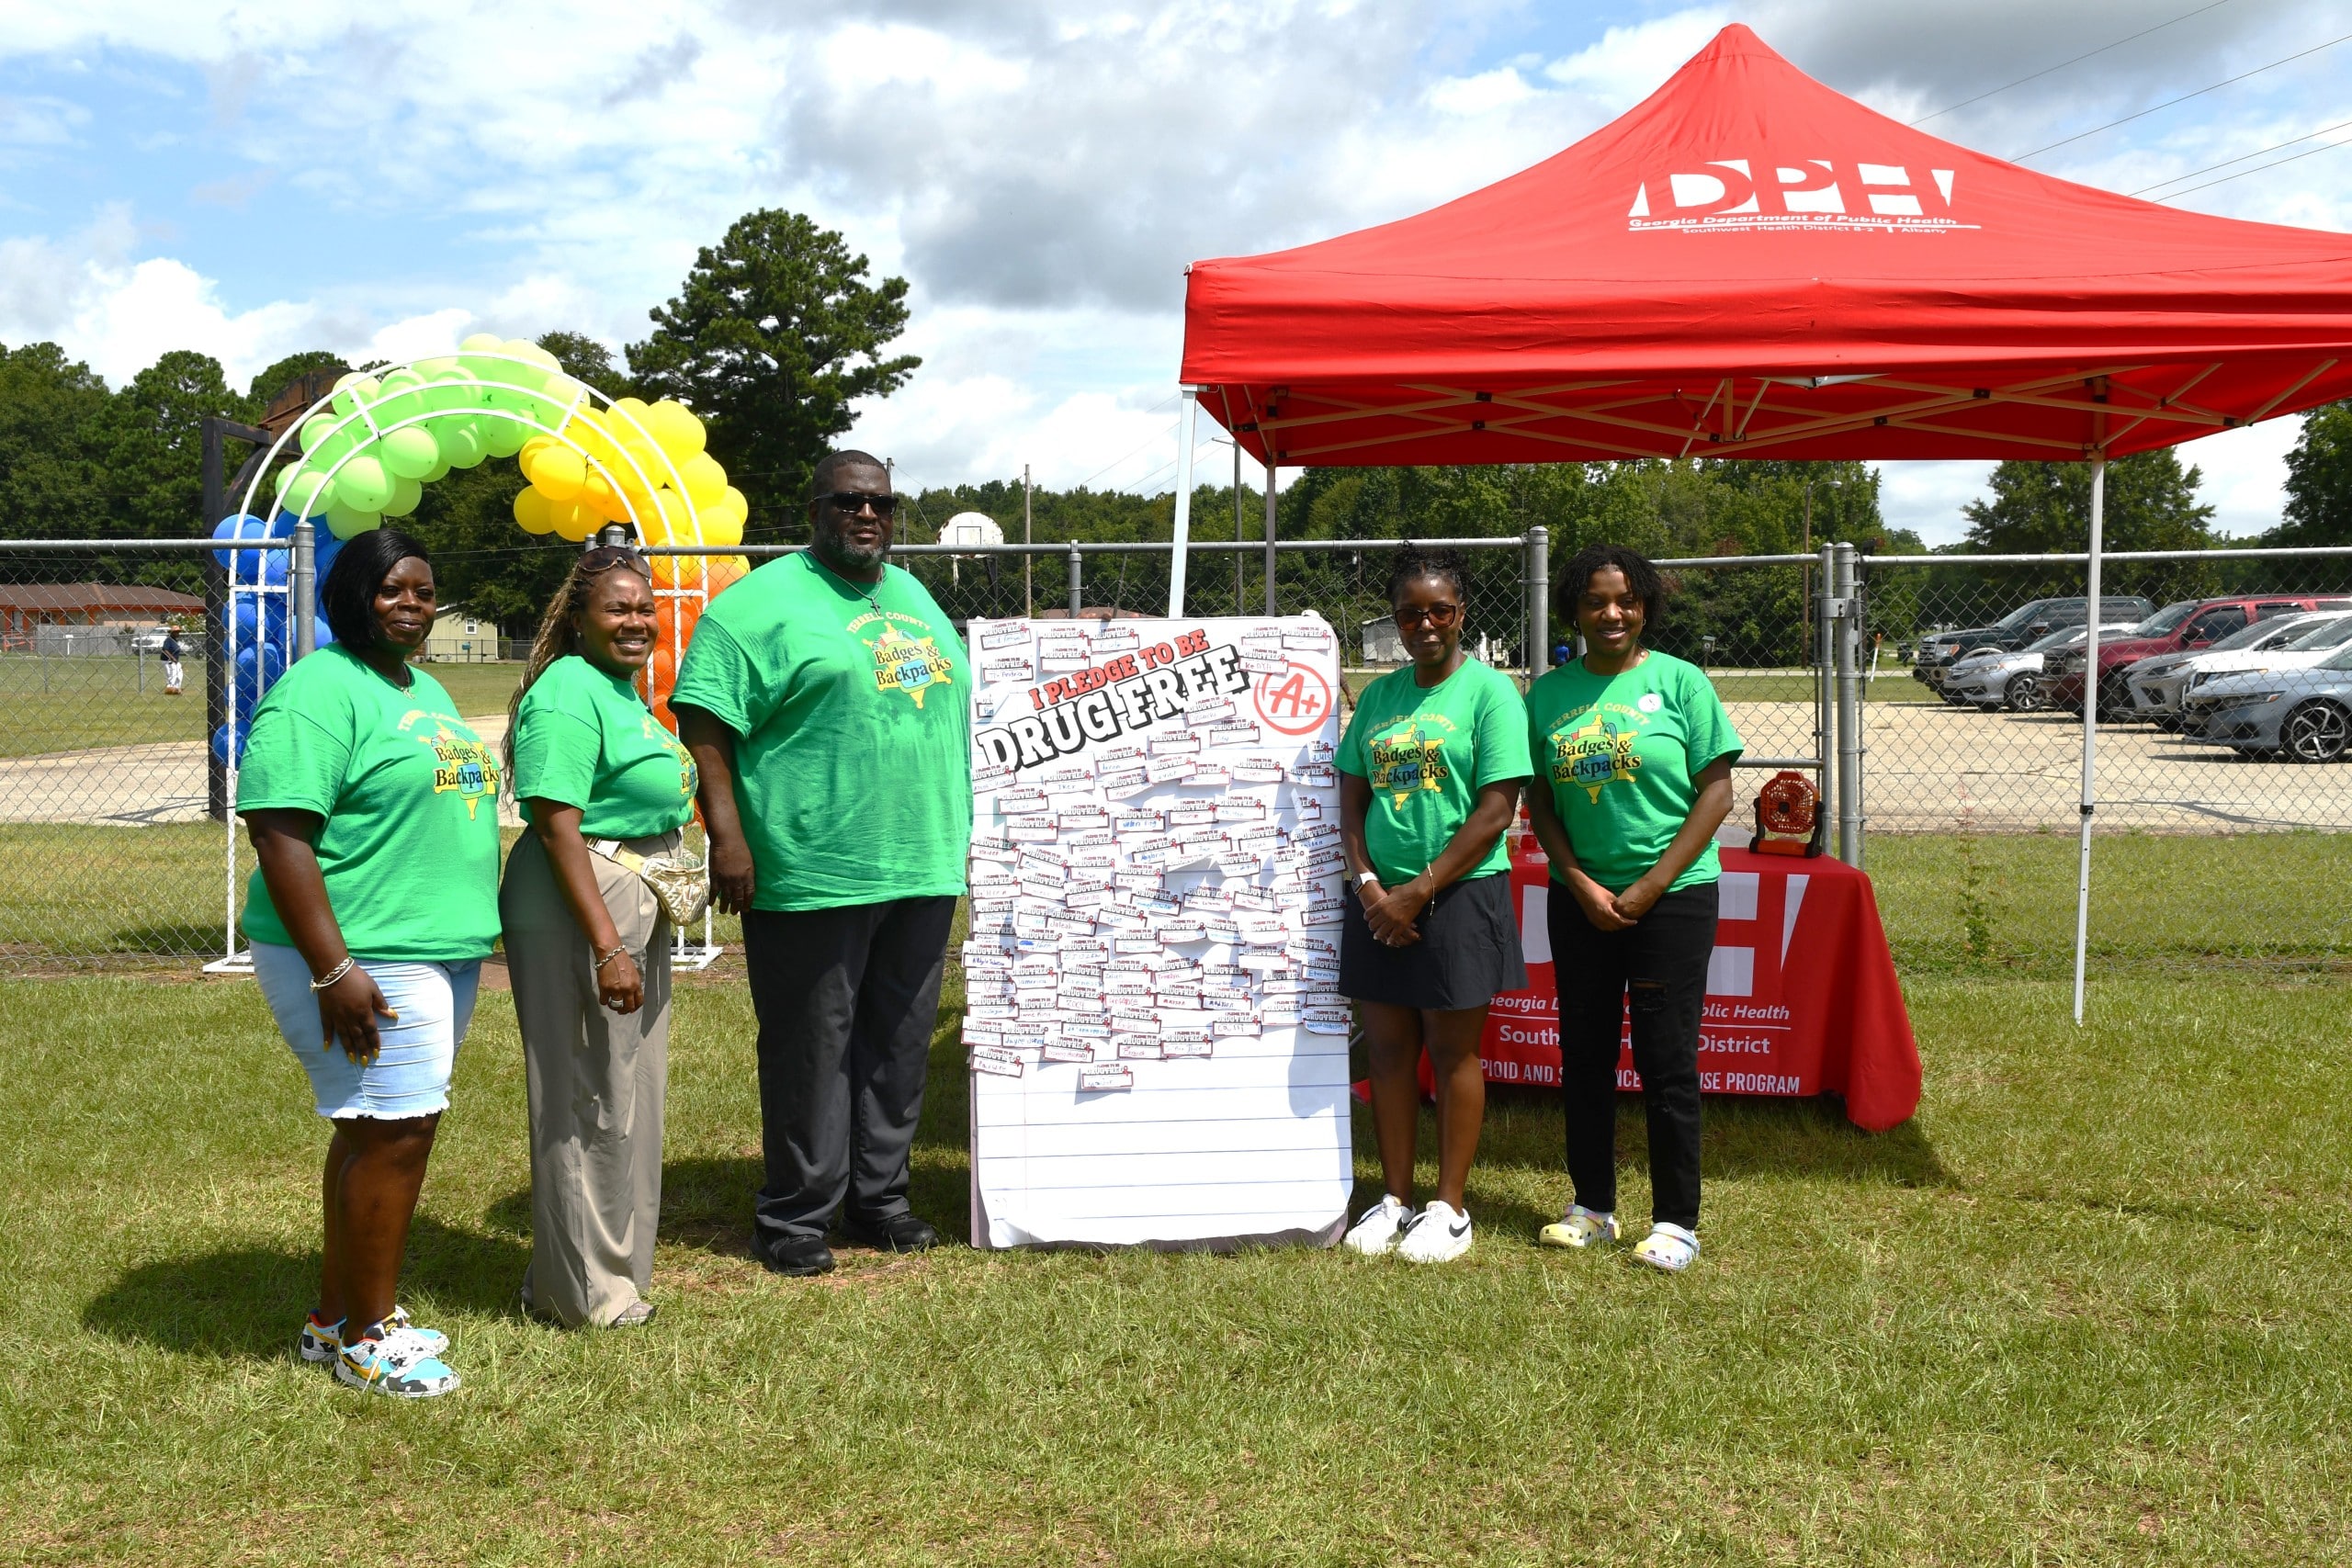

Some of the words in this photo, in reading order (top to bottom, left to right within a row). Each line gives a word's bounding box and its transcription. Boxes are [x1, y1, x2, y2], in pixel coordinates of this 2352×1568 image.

[1629, 218, 1697, 228] Georgia
[1702, 215, 1808, 224] Department
[1837, 215, 1891, 224] Public
[1897, 217, 1957, 225] Health
[875, 645, 923, 664] Badges
[925, 645, 939, 657] &
[875, 658, 952, 685] Backpacks
[1028, 688, 1044, 710] I
[1043, 654, 1139, 705] PLEDGE
[1137, 642, 1174, 670] TO
[1174, 628, 1211, 659] BE
[1269, 672, 1321, 718] A+
[435, 745, 478, 763] Badges
[481, 750, 492, 765] &
[1373, 747, 1422, 764] Badges
[1425, 749, 1440, 763] &
[1556, 739, 1614, 759] Badges
[1617, 739, 1632, 753] &
[435, 766, 500, 789] Backpacks
[1372, 764, 1448, 785] Backpacks
[1553, 756, 1640, 780] Backpacks
[1734, 1004, 1790, 1021] Health
[1499, 1024, 1560, 1046] South
[1698, 1034, 1770, 1054] District
[1480, 1058, 1518, 1079] PIOID
[1522, 1065, 1554, 1084] AND
[1726, 1072, 1801, 1094] PROGRAM
